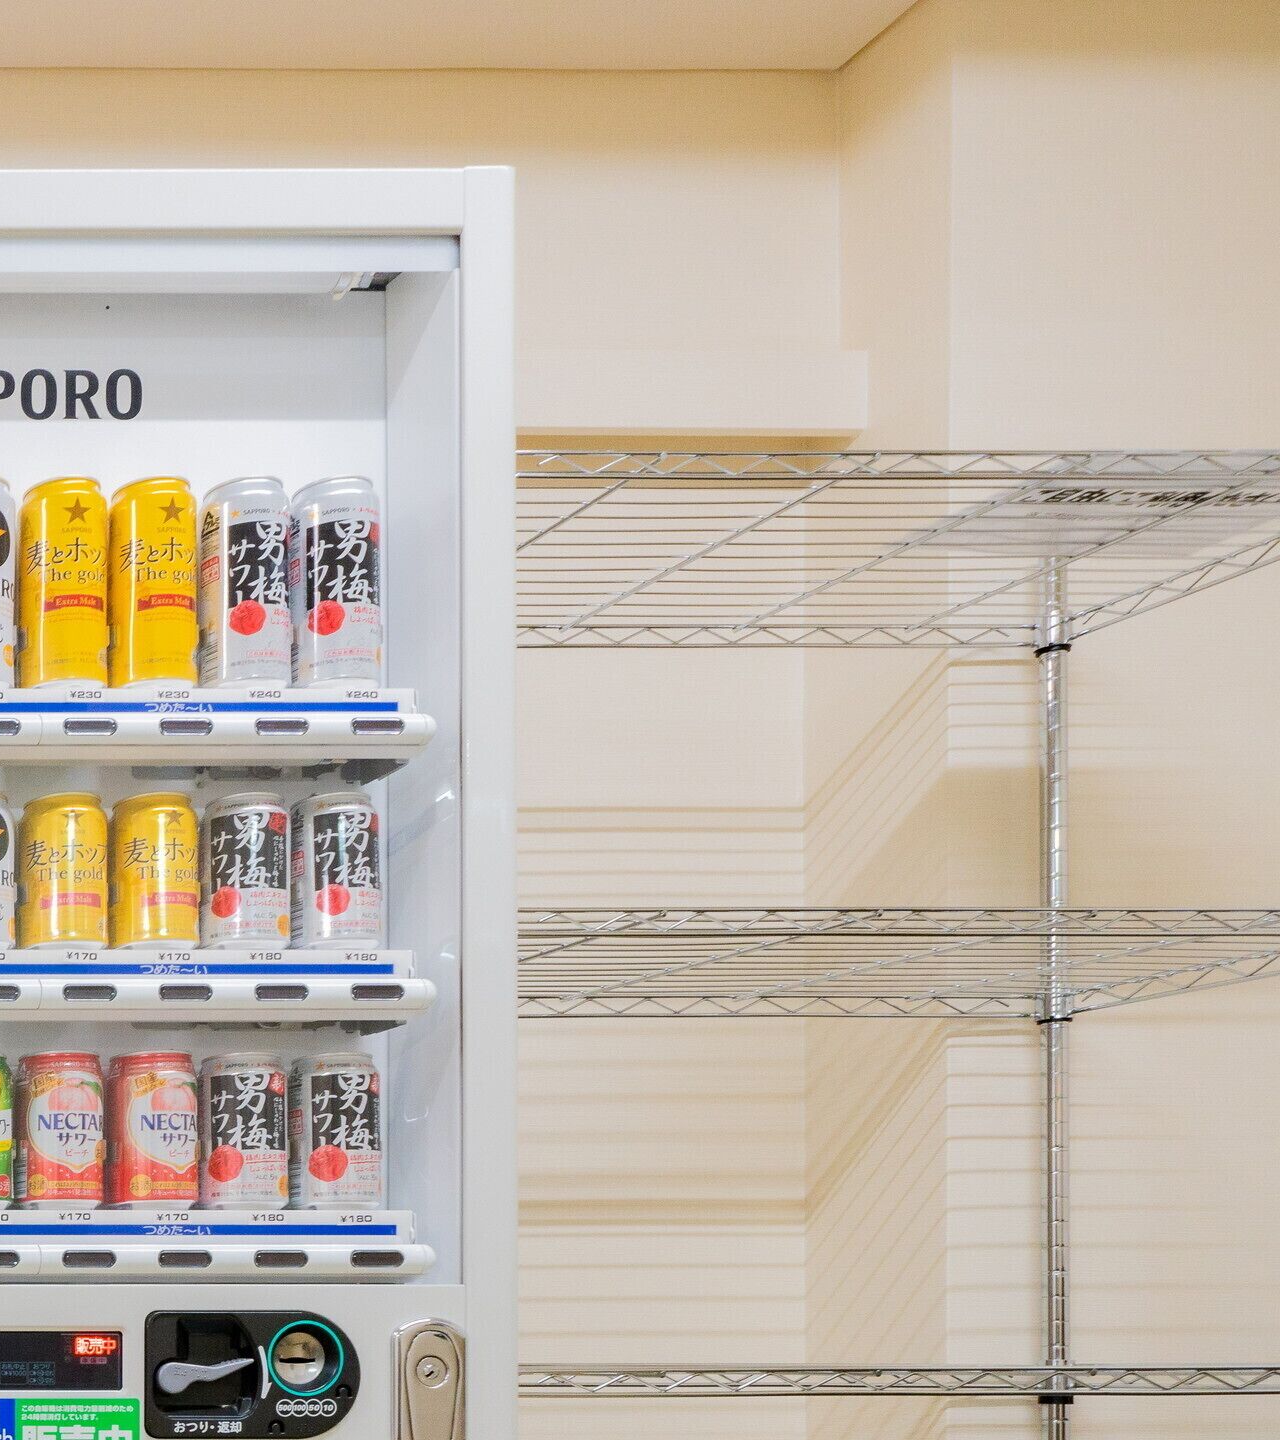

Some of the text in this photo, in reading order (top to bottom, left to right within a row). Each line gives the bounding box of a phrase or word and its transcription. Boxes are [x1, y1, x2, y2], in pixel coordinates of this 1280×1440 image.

[250, 520, 289, 606] 男梅
[327, 520, 374, 606] 男梅
[157, 691, 189, 699] ¥230
[346, 691, 378, 699] ¥240
[159, 953, 190, 961] ¥170
[345, 953, 377, 961] ¥180
[56, 1133, 96, 1146] サワー
[157, 1213, 189, 1221] ¥170
[74, 1337, 117, 1356] 販売中
[173, 1421, 242, 1434] おつり・返却
